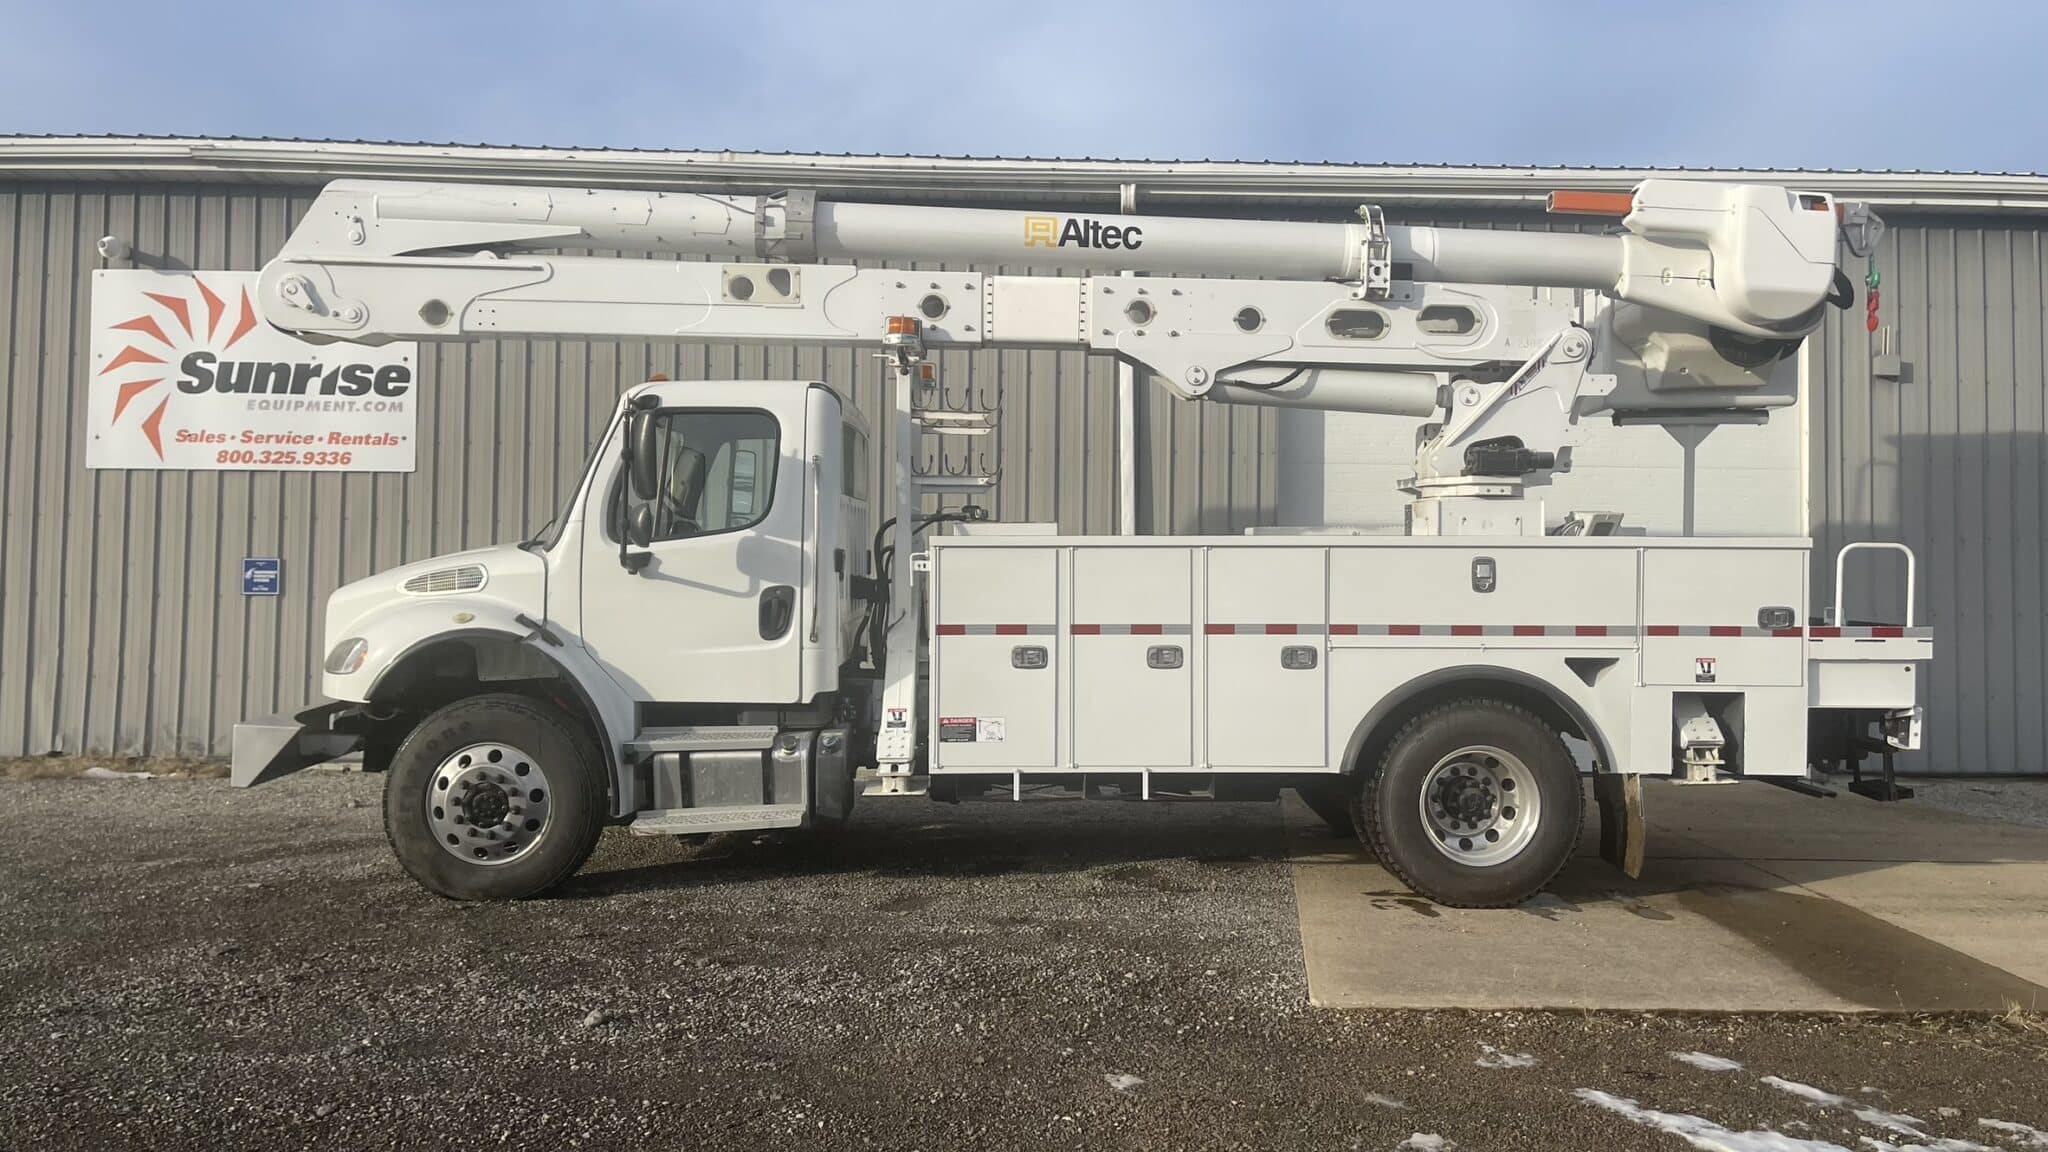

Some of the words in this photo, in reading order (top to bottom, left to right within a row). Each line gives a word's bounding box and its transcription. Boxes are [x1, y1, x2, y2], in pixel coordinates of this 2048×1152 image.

[1058, 218, 1143, 250] Altec
[177, 351, 411, 397] Sunrise
[247, 399, 404, 413] EQUIPMENT.COM
[175, 429, 226, 444] Sales
[240, 430, 315, 445] Service
[327, 431, 399, 446] Rentals
[216, 450, 352, 466] 800.325.9336
